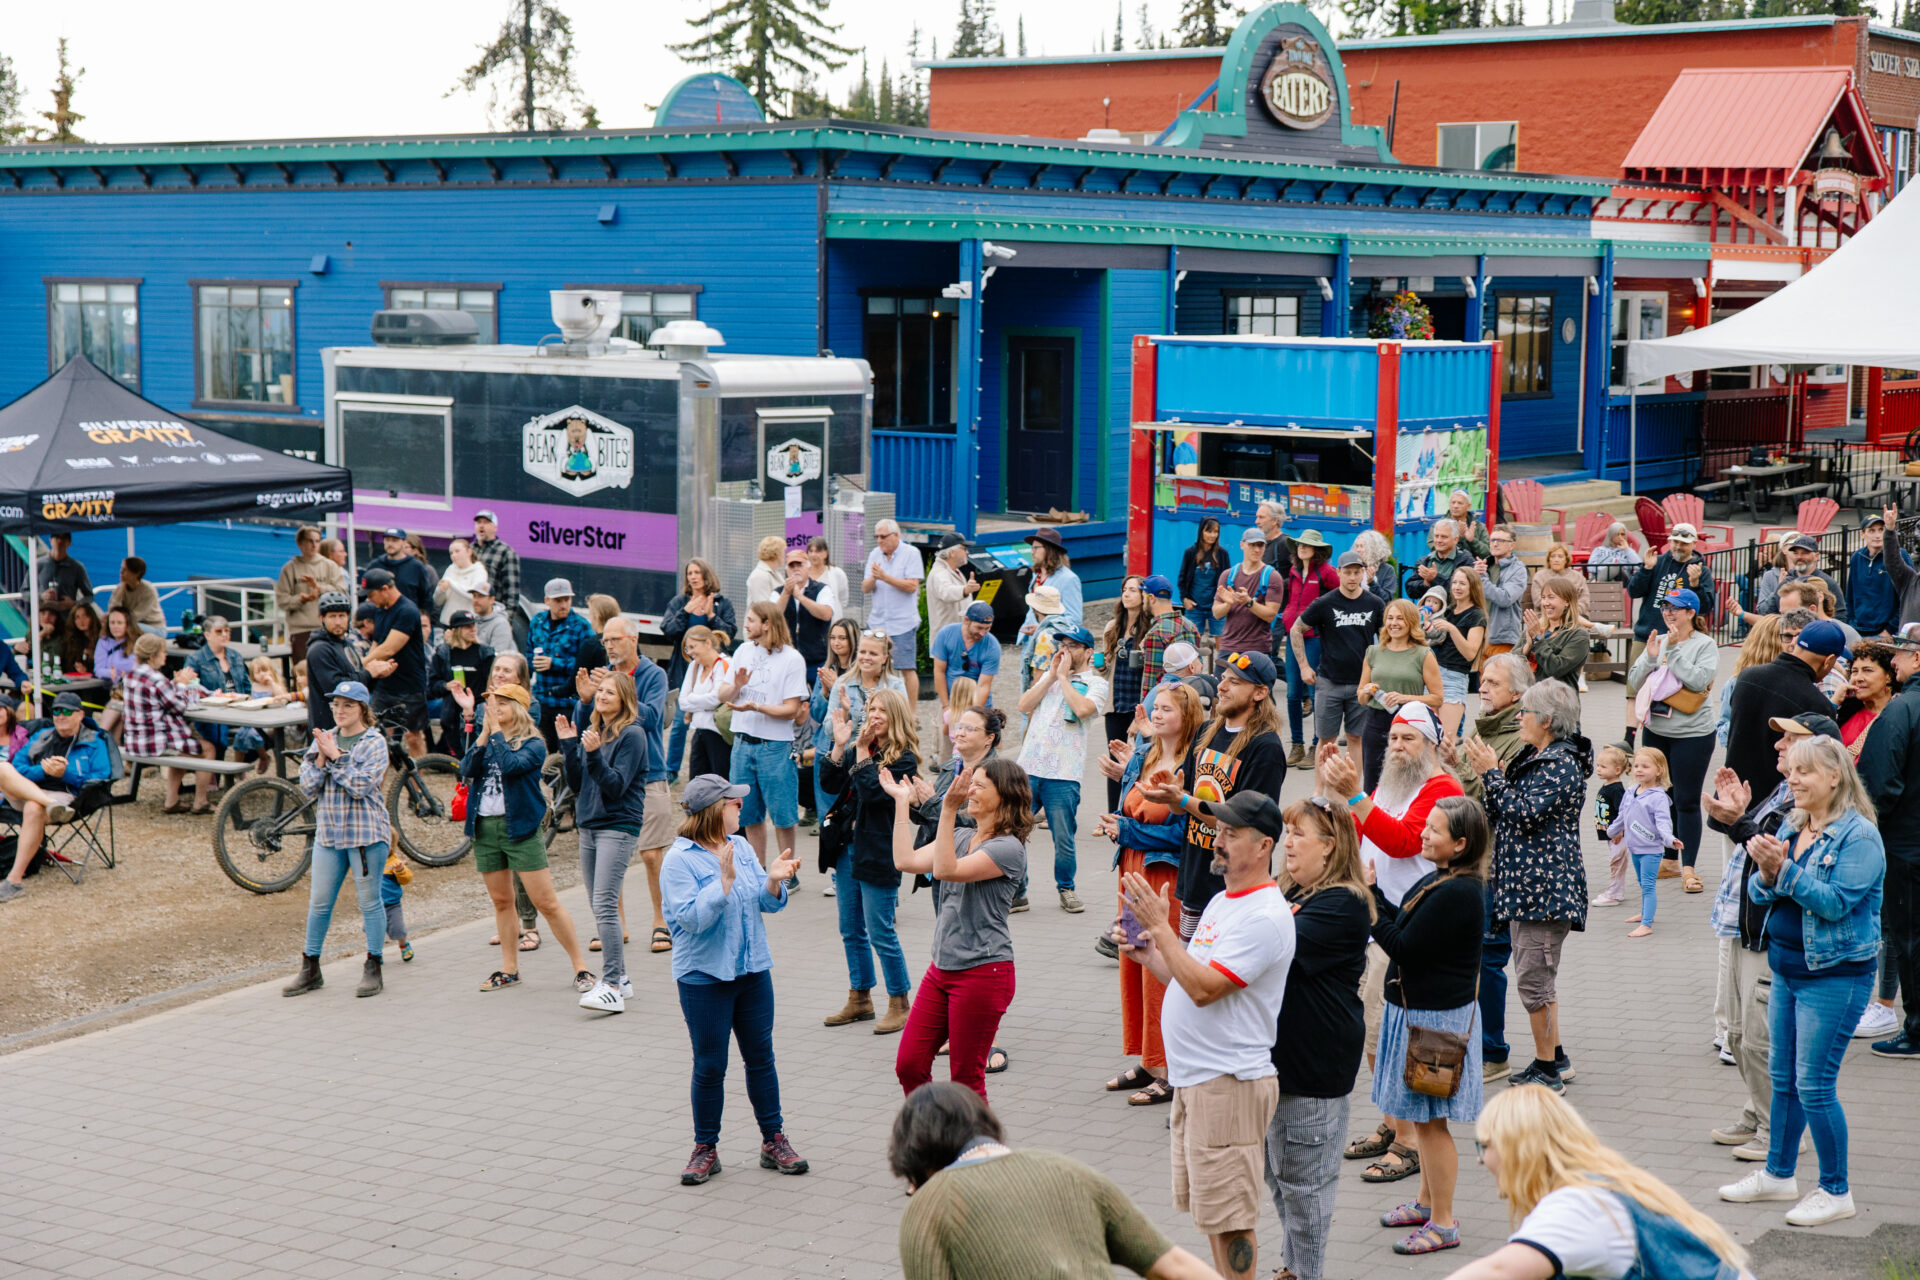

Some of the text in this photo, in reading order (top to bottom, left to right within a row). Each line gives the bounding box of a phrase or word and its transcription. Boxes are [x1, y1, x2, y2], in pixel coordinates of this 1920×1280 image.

[1870, 51, 1900, 76] SILVER
[1272, 72, 1329, 116] EATERY
[78, 420, 188, 432] SILVERSTAR
[88, 428, 195, 445] GRAVITY
[527, 432, 629, 468] BEAR BITES
[770, 454, 785, 471] BEAR
[42, 490, 116, 505] SILVERSTAR
[256, 487, 343, 508] ssgravity.ca
[42, 500, 114, 520] GRAVITY
[528, 520, 626, 550] SilverStar
